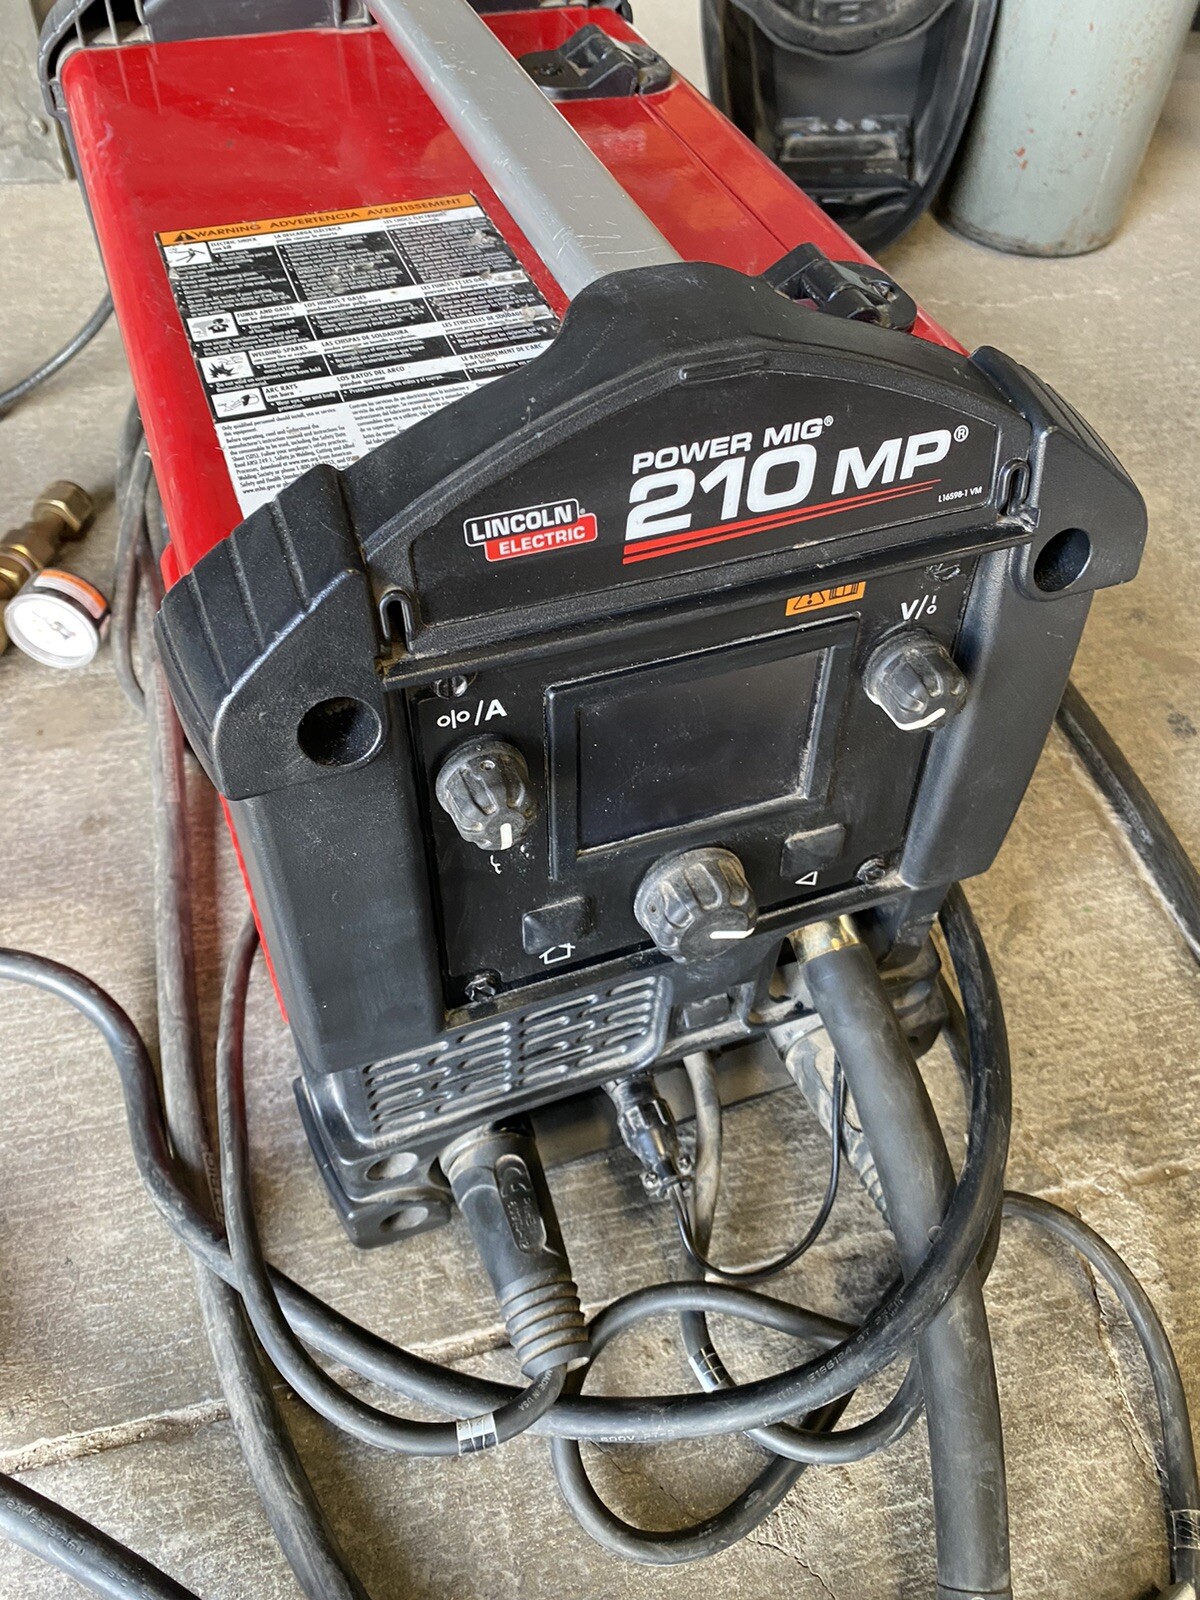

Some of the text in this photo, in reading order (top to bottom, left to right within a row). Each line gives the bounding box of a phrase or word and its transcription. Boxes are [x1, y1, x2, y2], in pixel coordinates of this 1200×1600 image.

[192, 198, 462, 237] WARNING ADVERTENCIA AVERTISSEMENT
[370, 329, 409, 338] SOLDADURA
[251, 344, 308, 357] WELDING SPARKS
[468, 348, 516, 359] RAYONNEMENT
[350, 371, 373, 379] RAYOS
[632, 432, 753, 475] POWER
[625, 443, 818, 541] 210
[970, 486, 983, 496] VM
[471, 504, 573, 542] LINCOLN
[499, 525, 586, 556] ELECTRIC
[538, 1369, 554, 1390] MADE
[518, 1396, 534, 1412] USA
